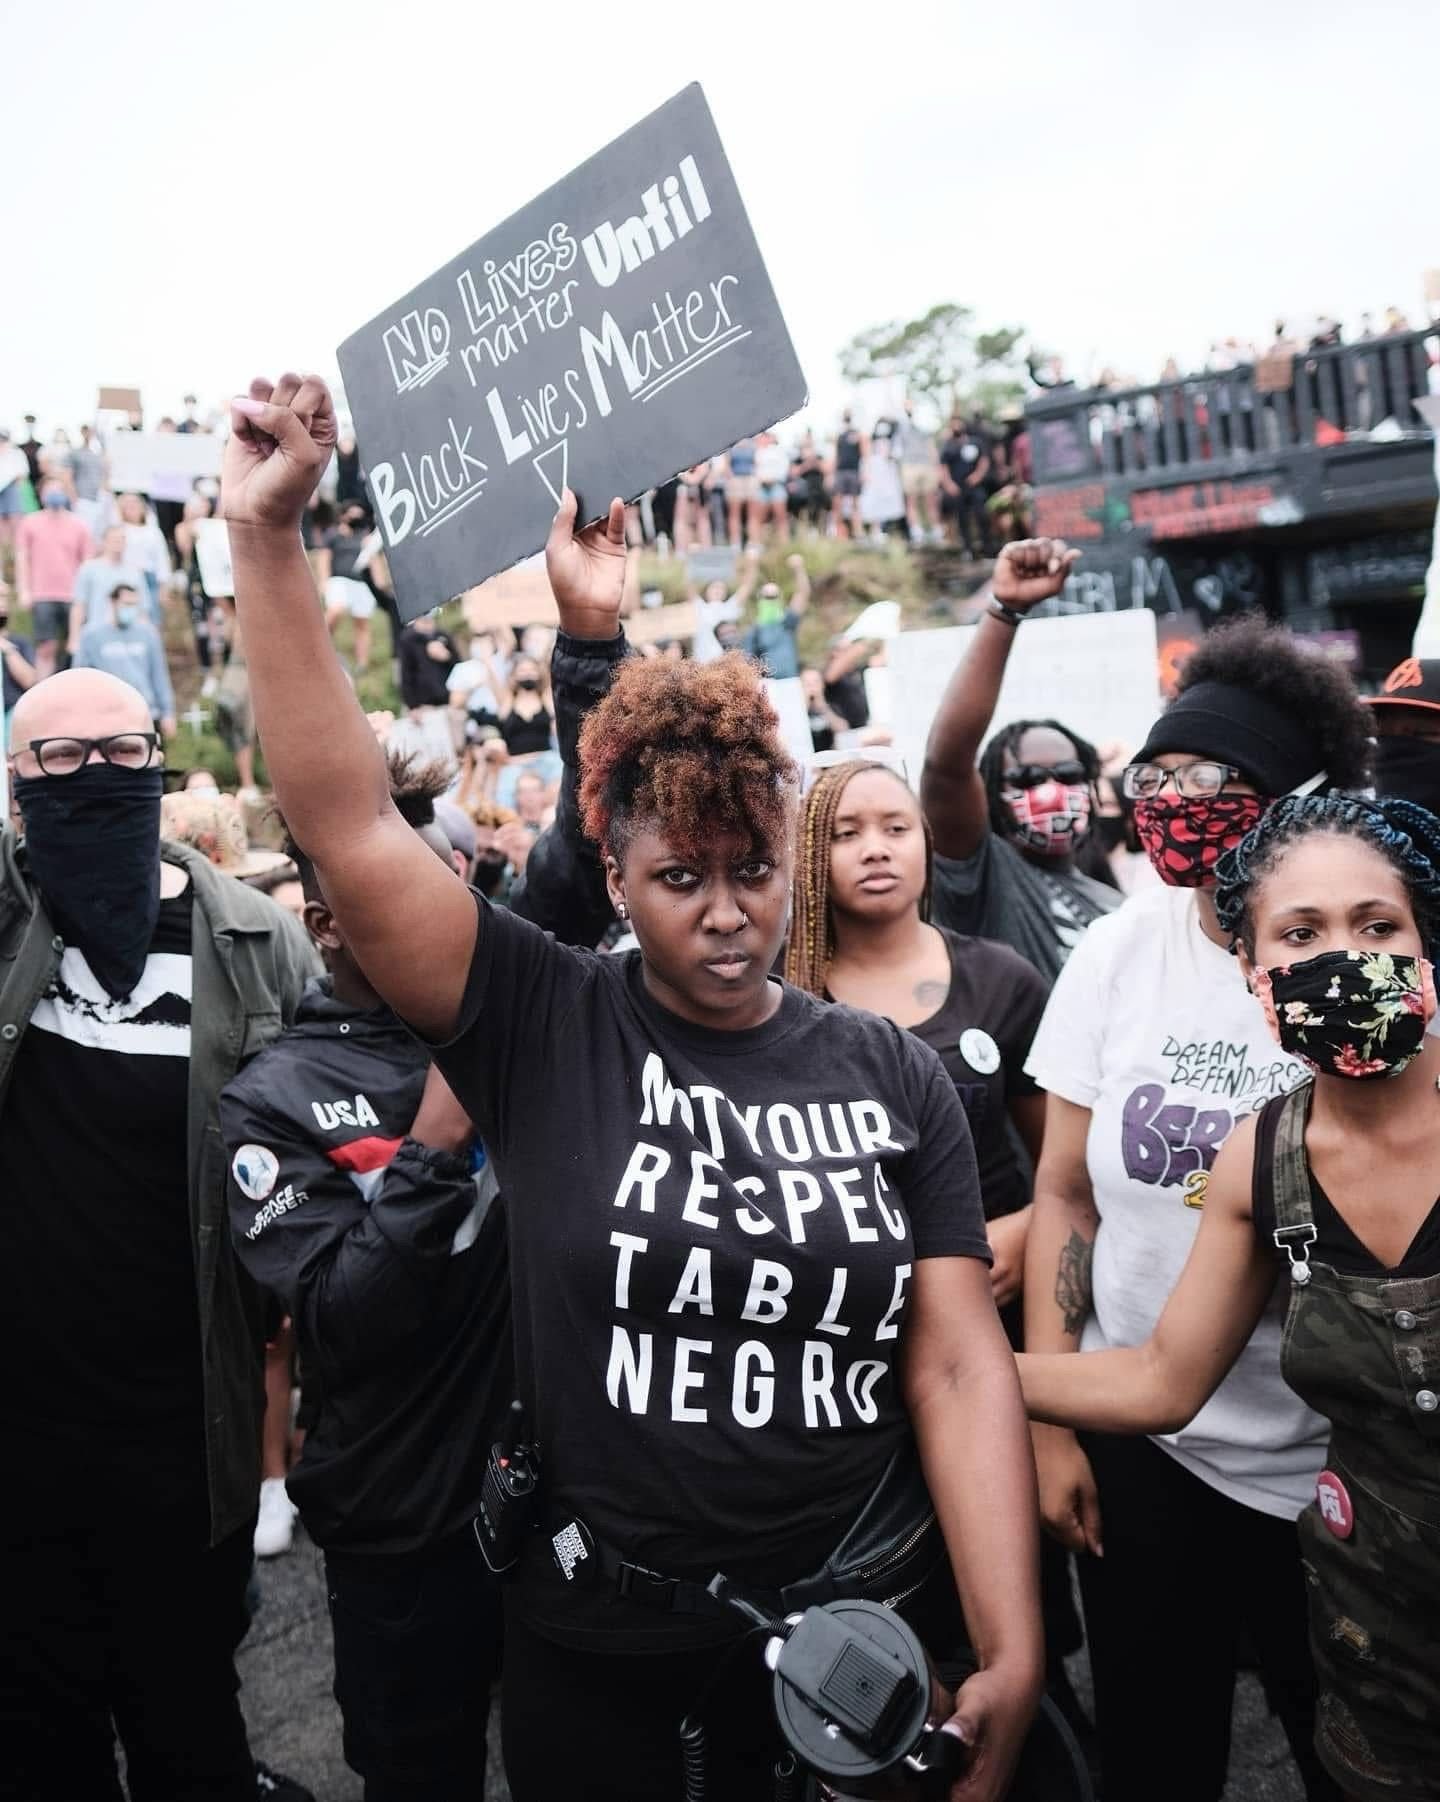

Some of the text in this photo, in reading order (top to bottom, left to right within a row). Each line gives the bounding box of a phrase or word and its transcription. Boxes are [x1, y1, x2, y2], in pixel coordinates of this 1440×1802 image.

[457, 222, 577, 335] Lives
[460, 154, 712, 387] matter Until
[370, 275, 740, 547] Black Lives Matter
[1161, 1035, 1249, 1067] DREAM
[312, 1094, 380, 1130] USA
[726, 1096, 906, 1163] YOUR
[613, 1141, 906, 1244] RESPEC
[609, 1231, 912, 1341] TABLE
[606, 1324, 889, 1428] NEGRO
